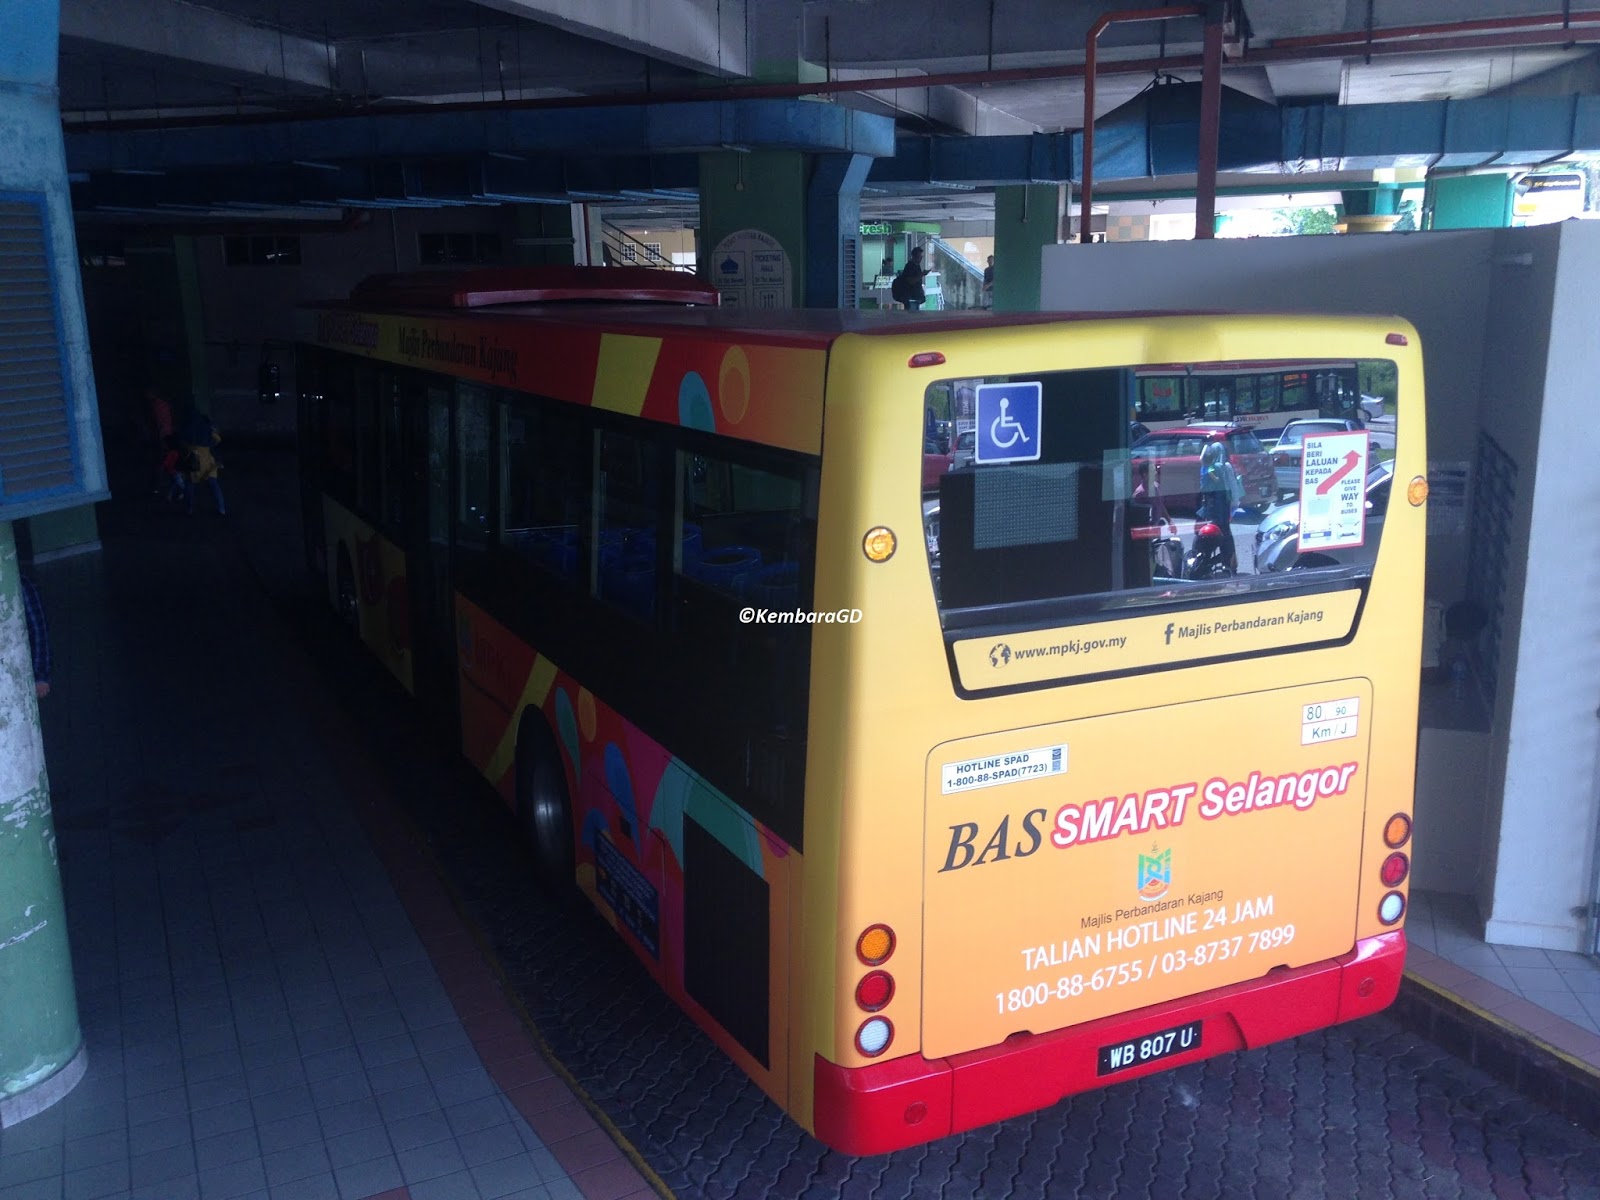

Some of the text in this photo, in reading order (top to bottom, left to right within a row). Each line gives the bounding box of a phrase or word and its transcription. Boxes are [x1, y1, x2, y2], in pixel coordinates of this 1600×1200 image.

[479, 335, 520, 384] Kajang
[1305, 467, 1332, 476] KEPADA
[1306, 457, 1338, 467] LALUAN
[1341, 493, 1359, 501] WAY
[1178, 622, 1211, 639] Majlis
[1214, 613, 1285, 634] Perbandaran
[1287, 609, 1324, 627] Kajang
[1014, 635, 1127, 660] www.mpkj.gov.my
[1306, 705, 1346, 720] 80 90
[947, 763, 1048, 787] 1-800-88-SPAD(7723)
[956, 754, 1029, 774] HOTLINE SPAD
[937, 763, 1357, 873] BAS SMART Selangor
[1080, 889, 1224, 930] Majlis Perbandaran Kajang
[1021, 895, 1274, 972] TALIAN HOTLINE 24 JAM
[995, 959, 1143, 1015] 1800-88-6755
[1161, 935, 1243, 974] 03-8737
[1249, 923, 1296, 952] 7899
[1110, 1027, 1193, 1069] WB 807 U
